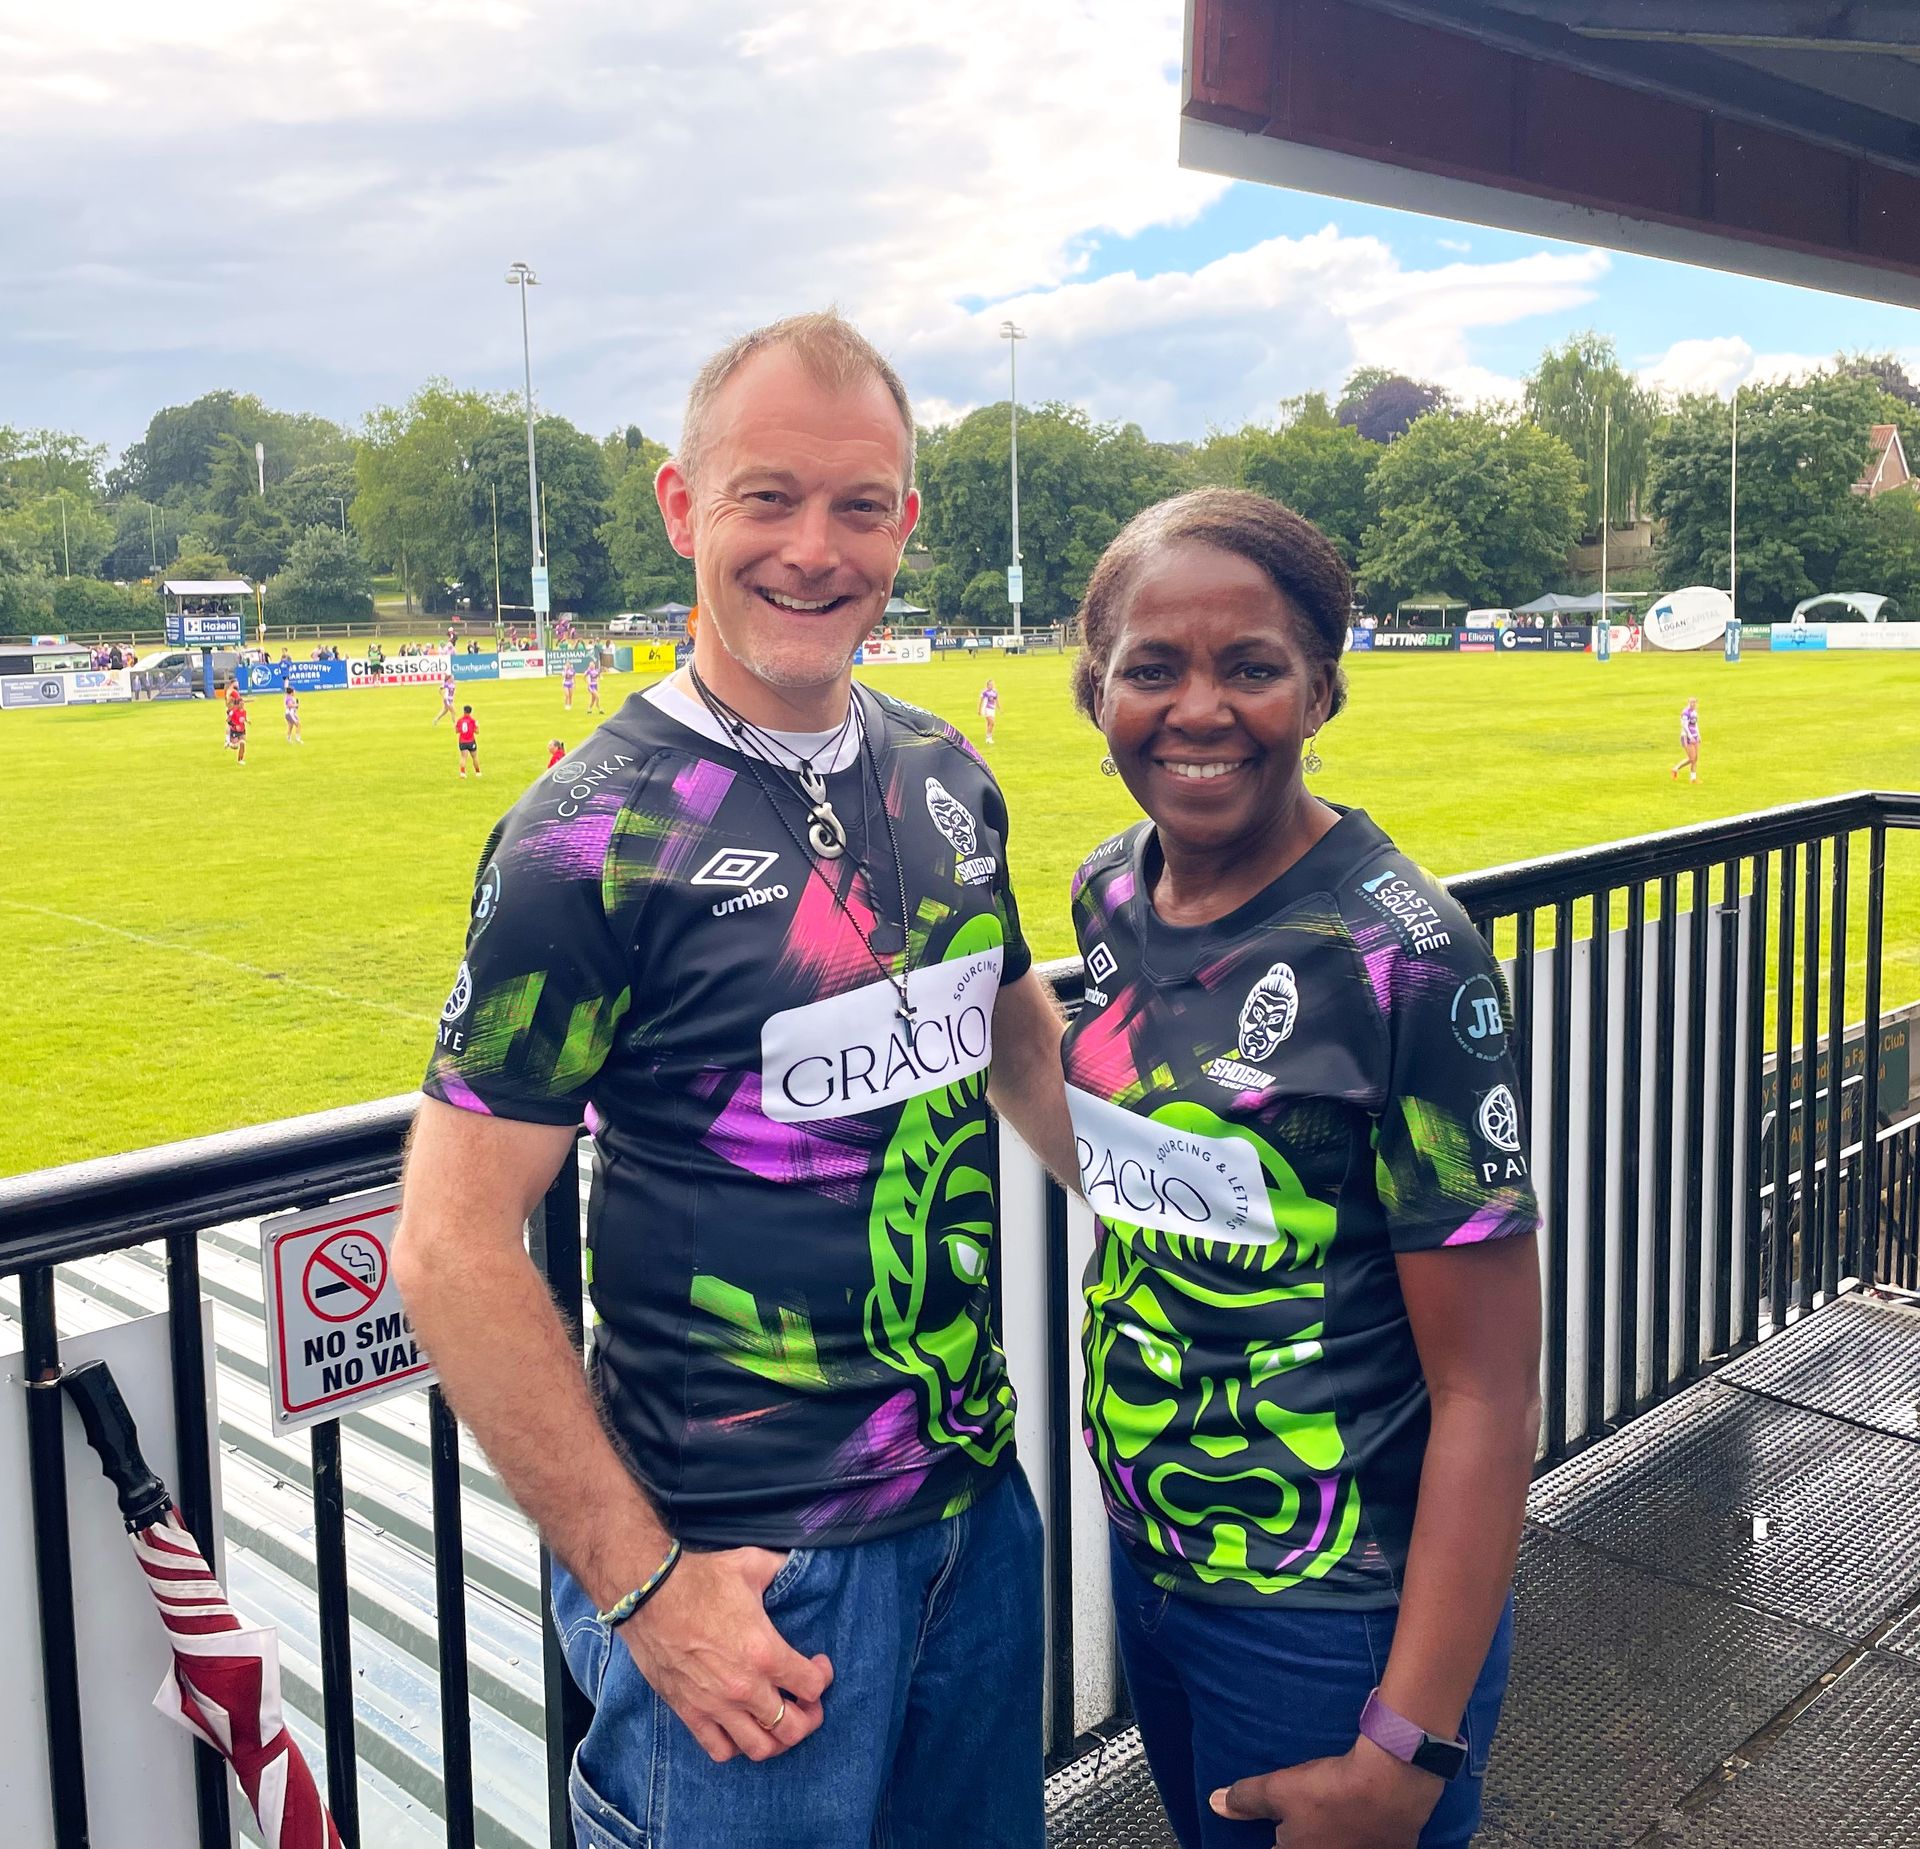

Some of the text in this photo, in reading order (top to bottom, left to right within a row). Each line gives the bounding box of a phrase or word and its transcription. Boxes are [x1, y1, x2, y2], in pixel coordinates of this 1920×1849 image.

[203, 621, 237, 631] Hazells
[1468, 632, 1495, 642] Ellisons
[1660, 620, 1687, 633] LOGAN
[298, 663, 332, 673] COUNTRY
[451, 662, 491, 673] Churchgates
[547, 650, 586, 660] HELMSMAN
[288, 671, 321, 680] ARRIERS
[955, 856, 997, 882] SHOGUN
[711, 881, 789, 917] umbro
[1390, 880, 1451, 946] CASTLE
[1374, 888, 1435, 955] SQUARE
[953, 960, 997, 1002] SOURCING
[1467, 997, 1504, 1039] JB
[782, 1005, 987, 1108] GRACIO
[1884, 1031, 1905, 1051] Club
[1207, 1058, 1277, 1090] SHOGUN
[1156, 1139, 1212, 1165] SOURCING
[1216, 1162, 1227, 1175] &
[304, 1330, 346, 1367] NO
[322, 1357, 364, 1394] NO
